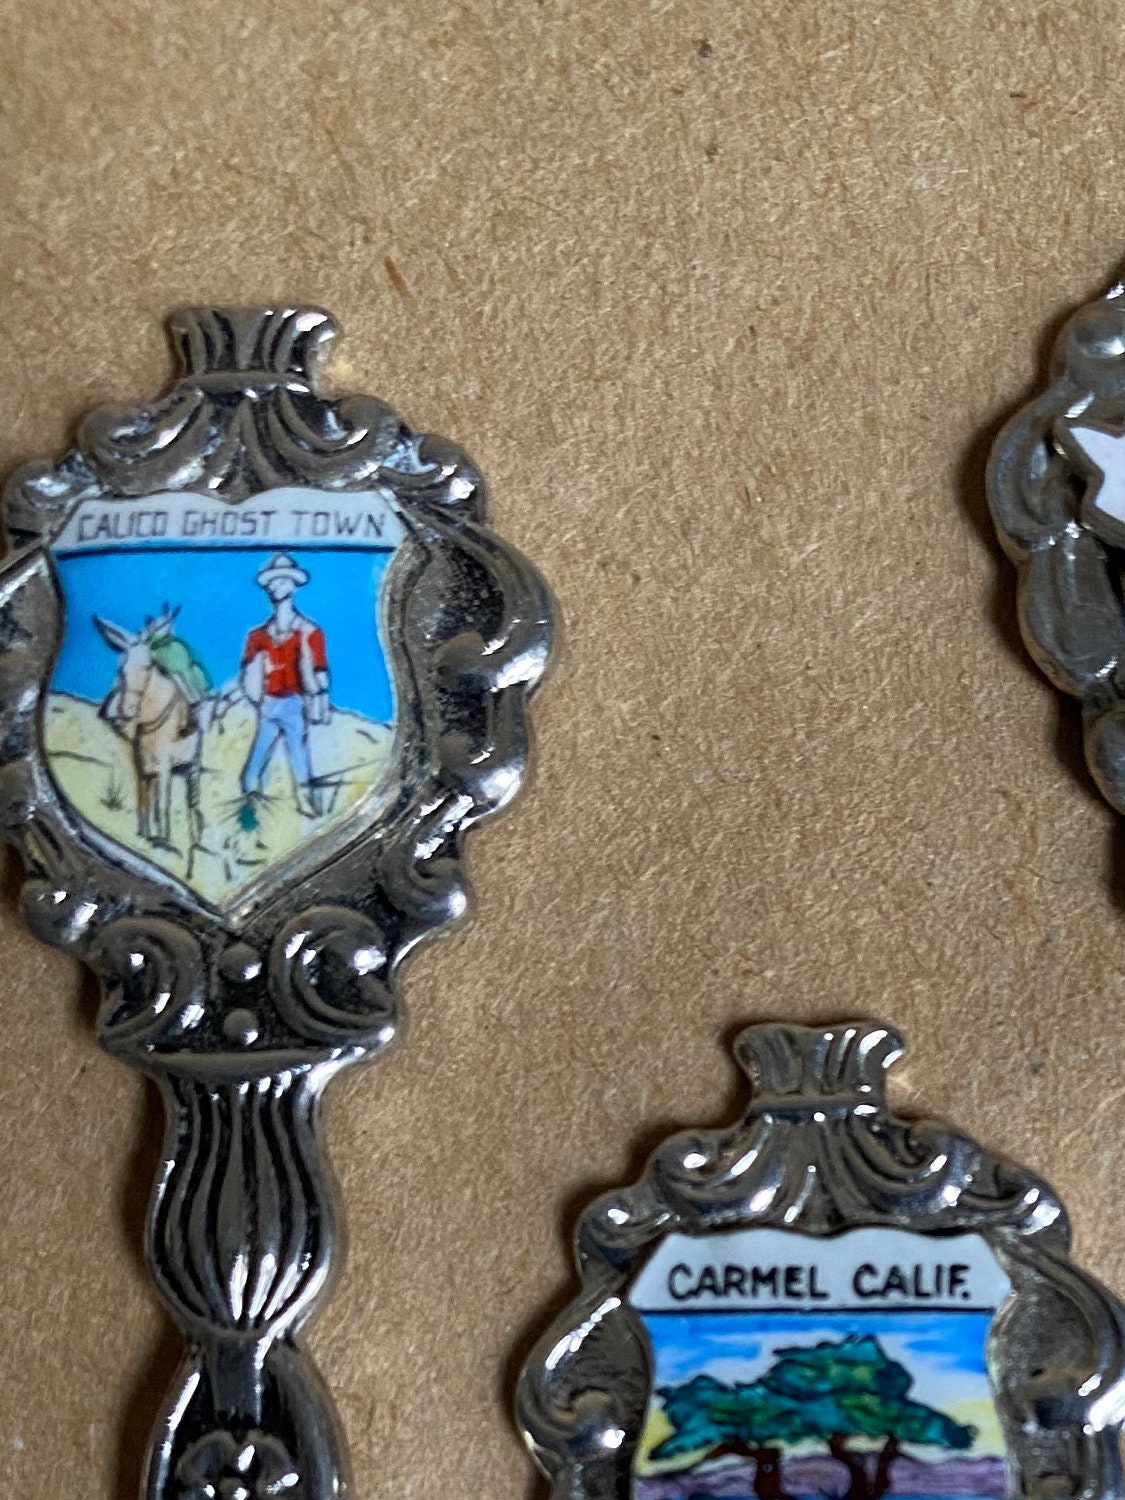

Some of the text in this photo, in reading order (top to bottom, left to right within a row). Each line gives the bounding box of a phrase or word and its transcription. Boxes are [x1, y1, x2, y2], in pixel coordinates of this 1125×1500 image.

[76, 509, 386, 542] CALICO GHOST TOWN
[667, 1263, 972, 1300] CARMEL CALIF.
